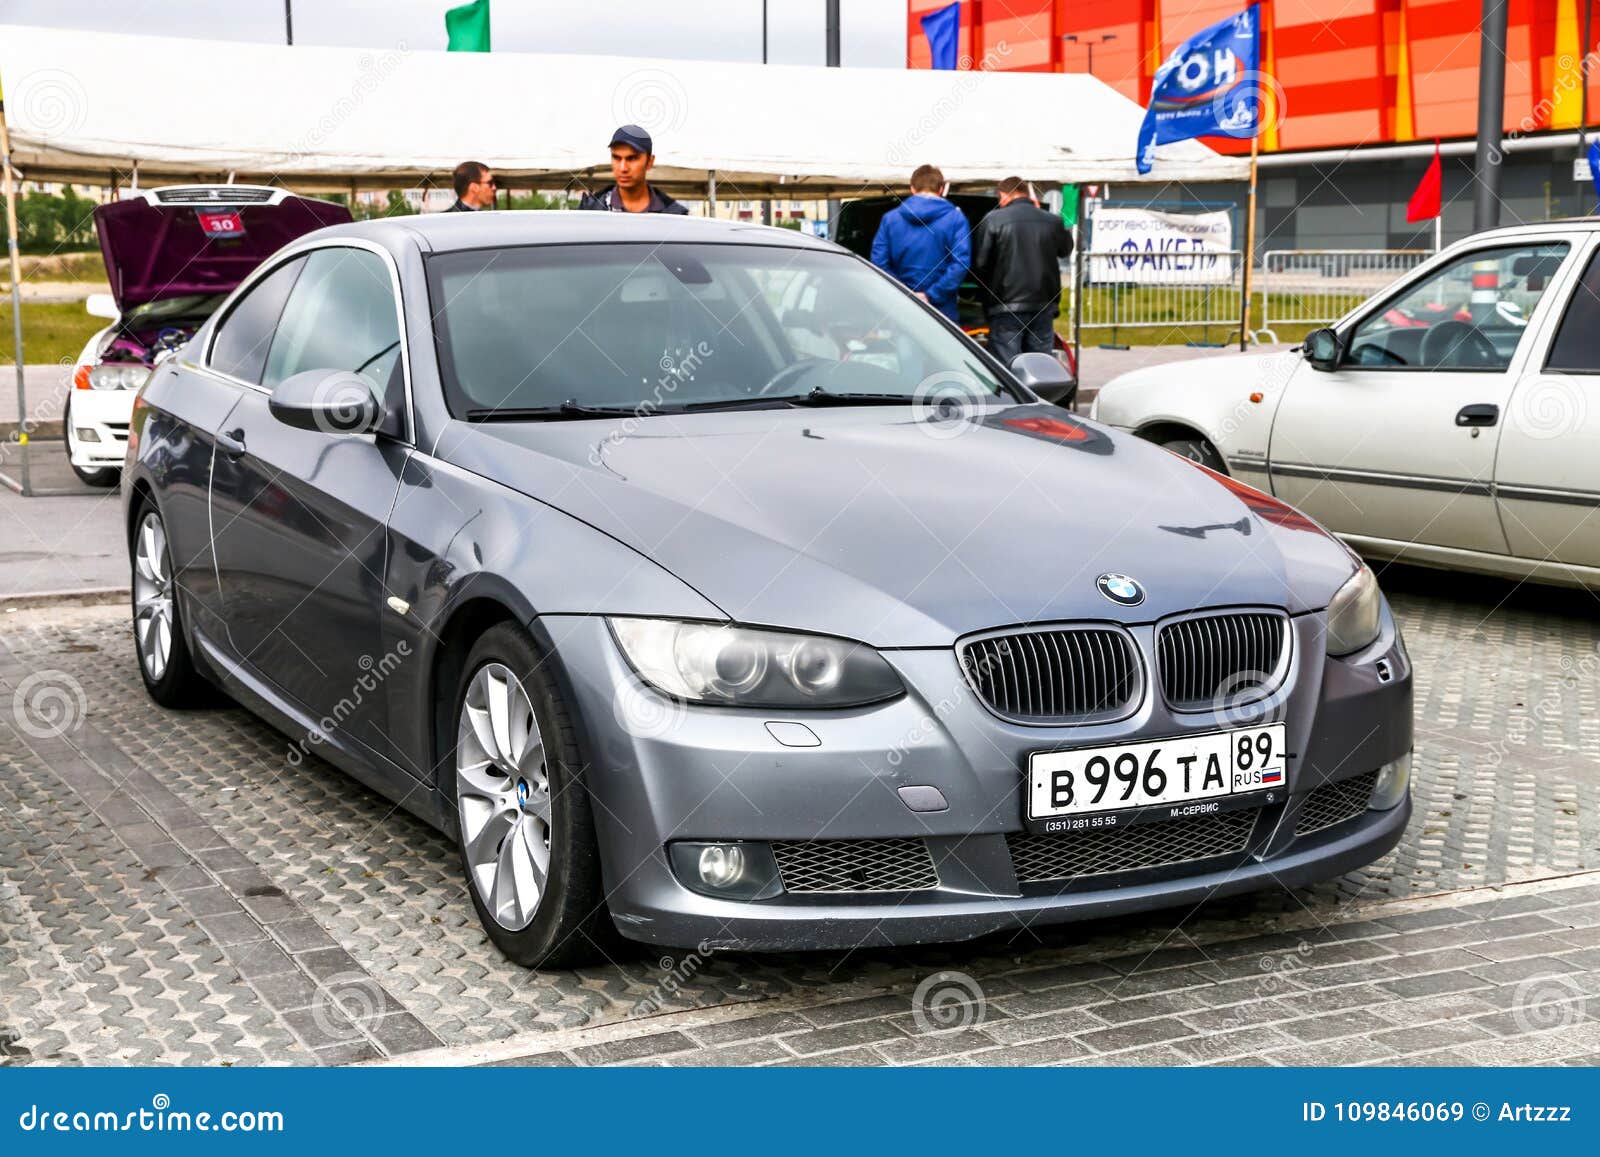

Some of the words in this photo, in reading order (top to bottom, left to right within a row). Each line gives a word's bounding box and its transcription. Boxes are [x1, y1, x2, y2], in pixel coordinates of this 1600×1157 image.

[210, 219, 234, 231] 30
[1237, 732, 1272, 770] 89
[1234, 771, 1261, 787] RUS
[1170, 803, 1219, 817] М-СЕРВИС
[1046, 821, 1071, 832] (351)
[1072, 820, 1089, 830] 281
[1091, 818, 1104, 827] 55
[1104, 816, 1117, 826] 55
